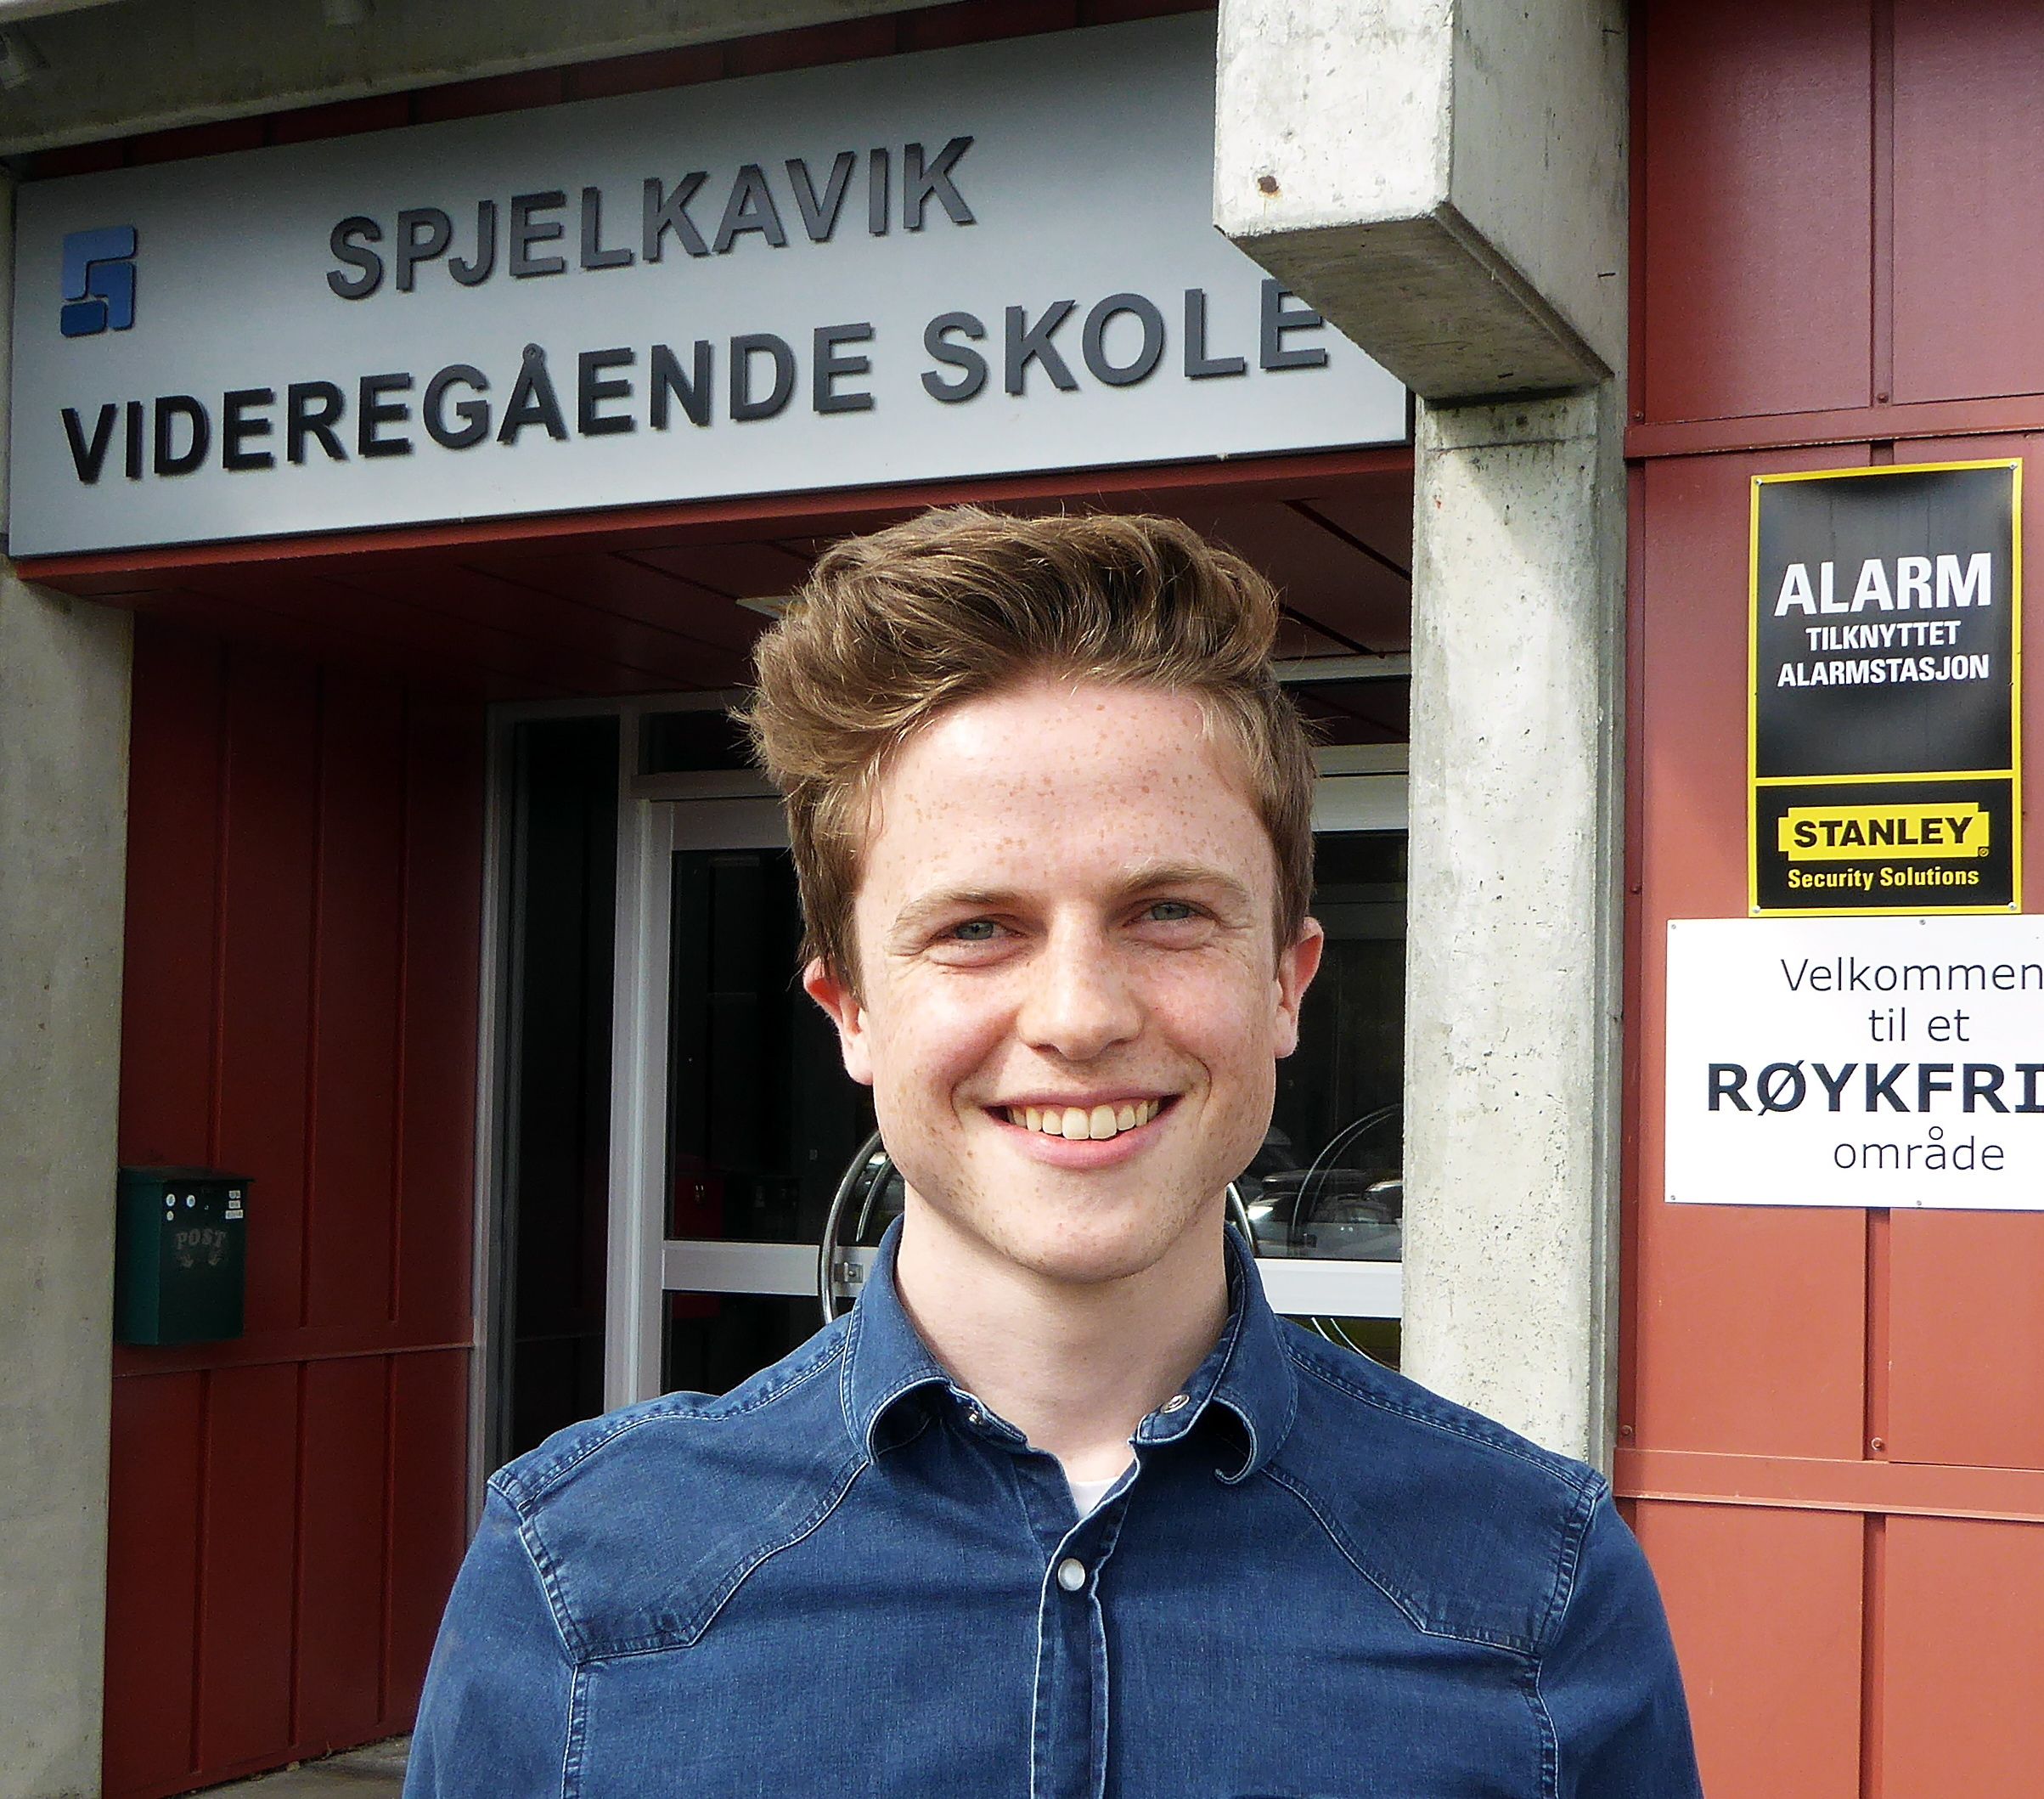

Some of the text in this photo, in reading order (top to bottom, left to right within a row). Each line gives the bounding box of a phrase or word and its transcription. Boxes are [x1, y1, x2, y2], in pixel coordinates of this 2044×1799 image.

[326, 136, 976, 299] SPJELKAVIK
[61, 279, 1328, 483] VIDEREGÅENDE SKOLE
[1774, 552, 1991, 617] ALARM
[1805, 620, 1962, 651] TILKNYTTET
[1777, 654, 1989, 687] ALARMSTASJON
[1793, 816, 1974, 848] STANLEY
[1788, 866, 1979, 891] Security Solutions
[1781, 956, 2043, 991] Velkommen
[1869, 1007, 1970, 1042] til et
[1708, 1060, 2044, 1116] RØYKFRI
[1833, 1126, 2005, 1171] område
[177, 1228, 228, 1249] POST
